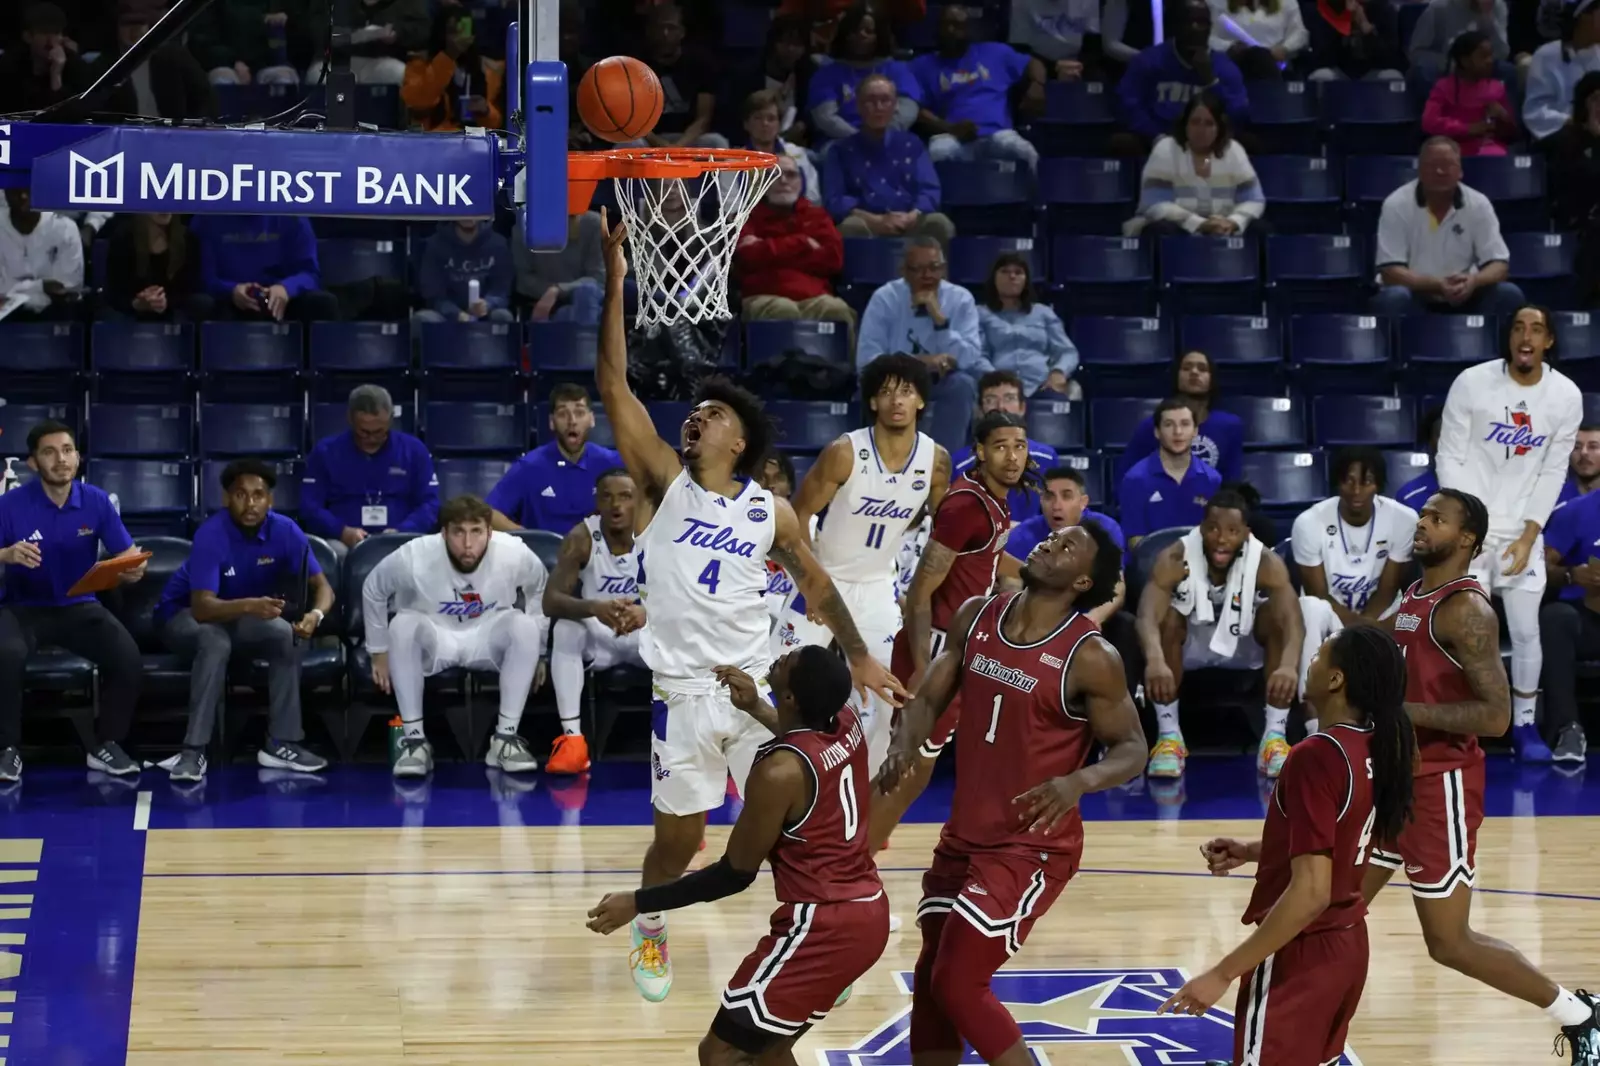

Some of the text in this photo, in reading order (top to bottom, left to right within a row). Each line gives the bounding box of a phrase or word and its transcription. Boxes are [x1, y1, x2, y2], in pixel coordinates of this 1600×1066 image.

[356, 164, 473, 206] BANK
[1485, 422, 1547, 447] Tulsa
[852, 496, 914, 519] Tulsa
[672, 517, 757, 558] Tulsa
[865, 523, 886, 549] 11
[597, 575, 640, 594] Tuls
[697, 558, 721, 594] 4
[984, 693, 1003, 744] 1
[839, 763, 859, 842] 0
[1354, 805, 1377, 865] 4
